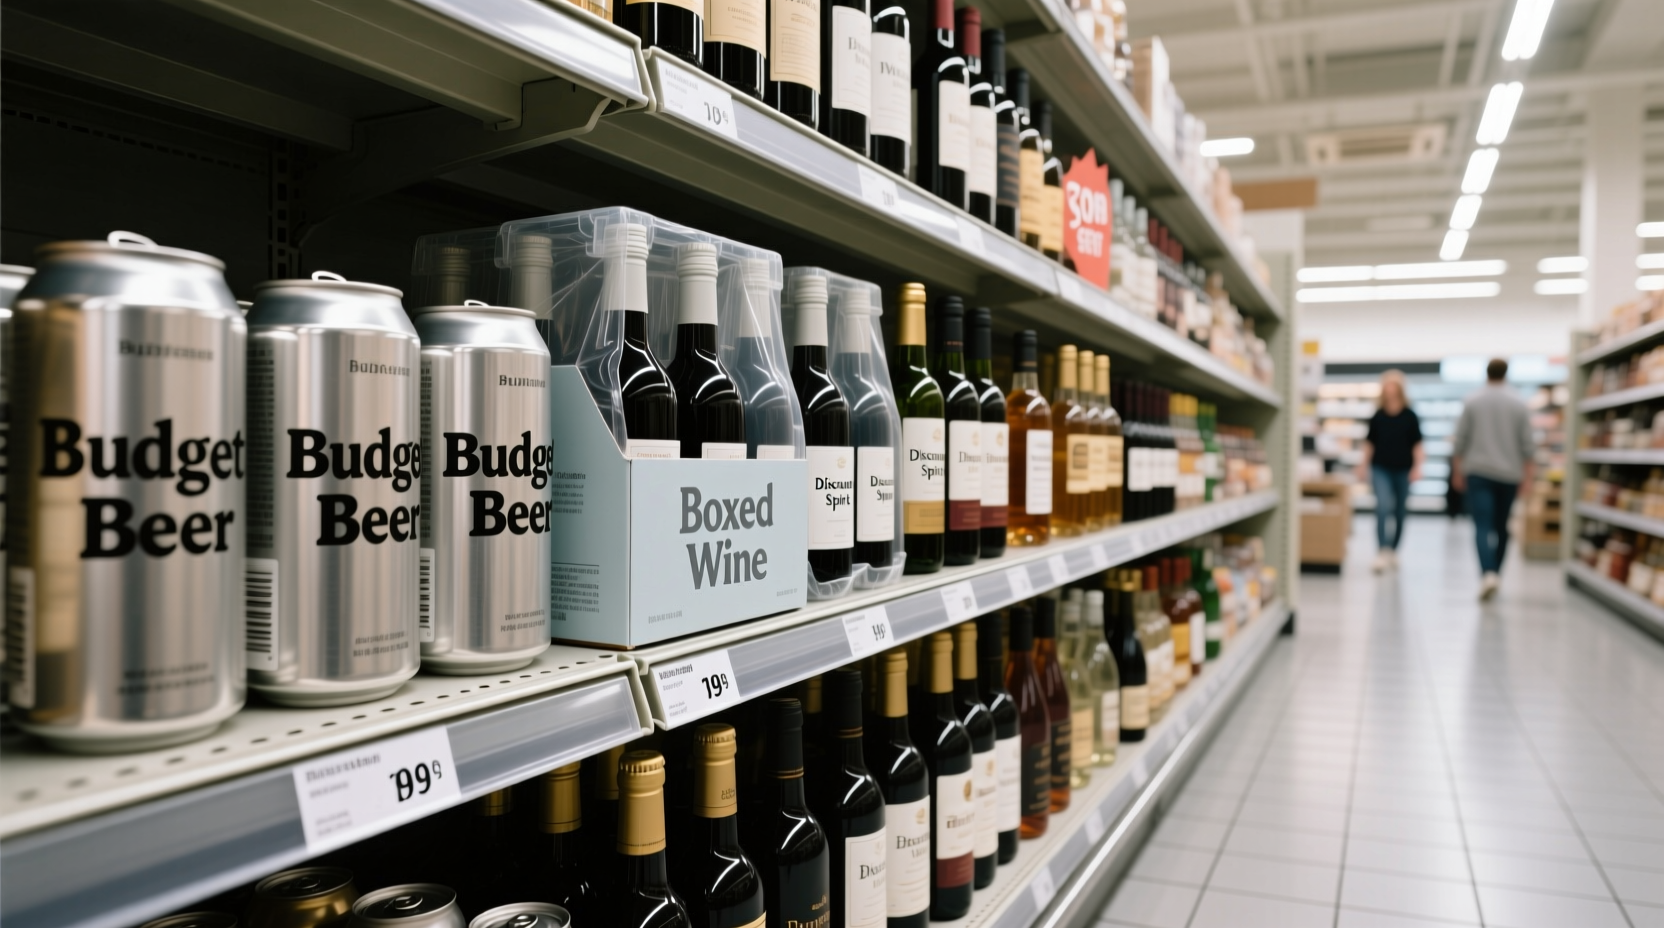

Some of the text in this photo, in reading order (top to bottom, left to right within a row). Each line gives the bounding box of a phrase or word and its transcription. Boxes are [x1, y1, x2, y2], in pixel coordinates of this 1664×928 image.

[39, 418, 245, 496] Budget
[286, 426, 422, 493] Budge
[442, 430, 554, 490] Budge
[80, 497, 235, 560] Beer
[316, 494, 421, 546] Beer
[469, 490, 552, 537] Beer
[679, 482, 774, 534] Boxed
[686, 538, 768, 590] Wine
